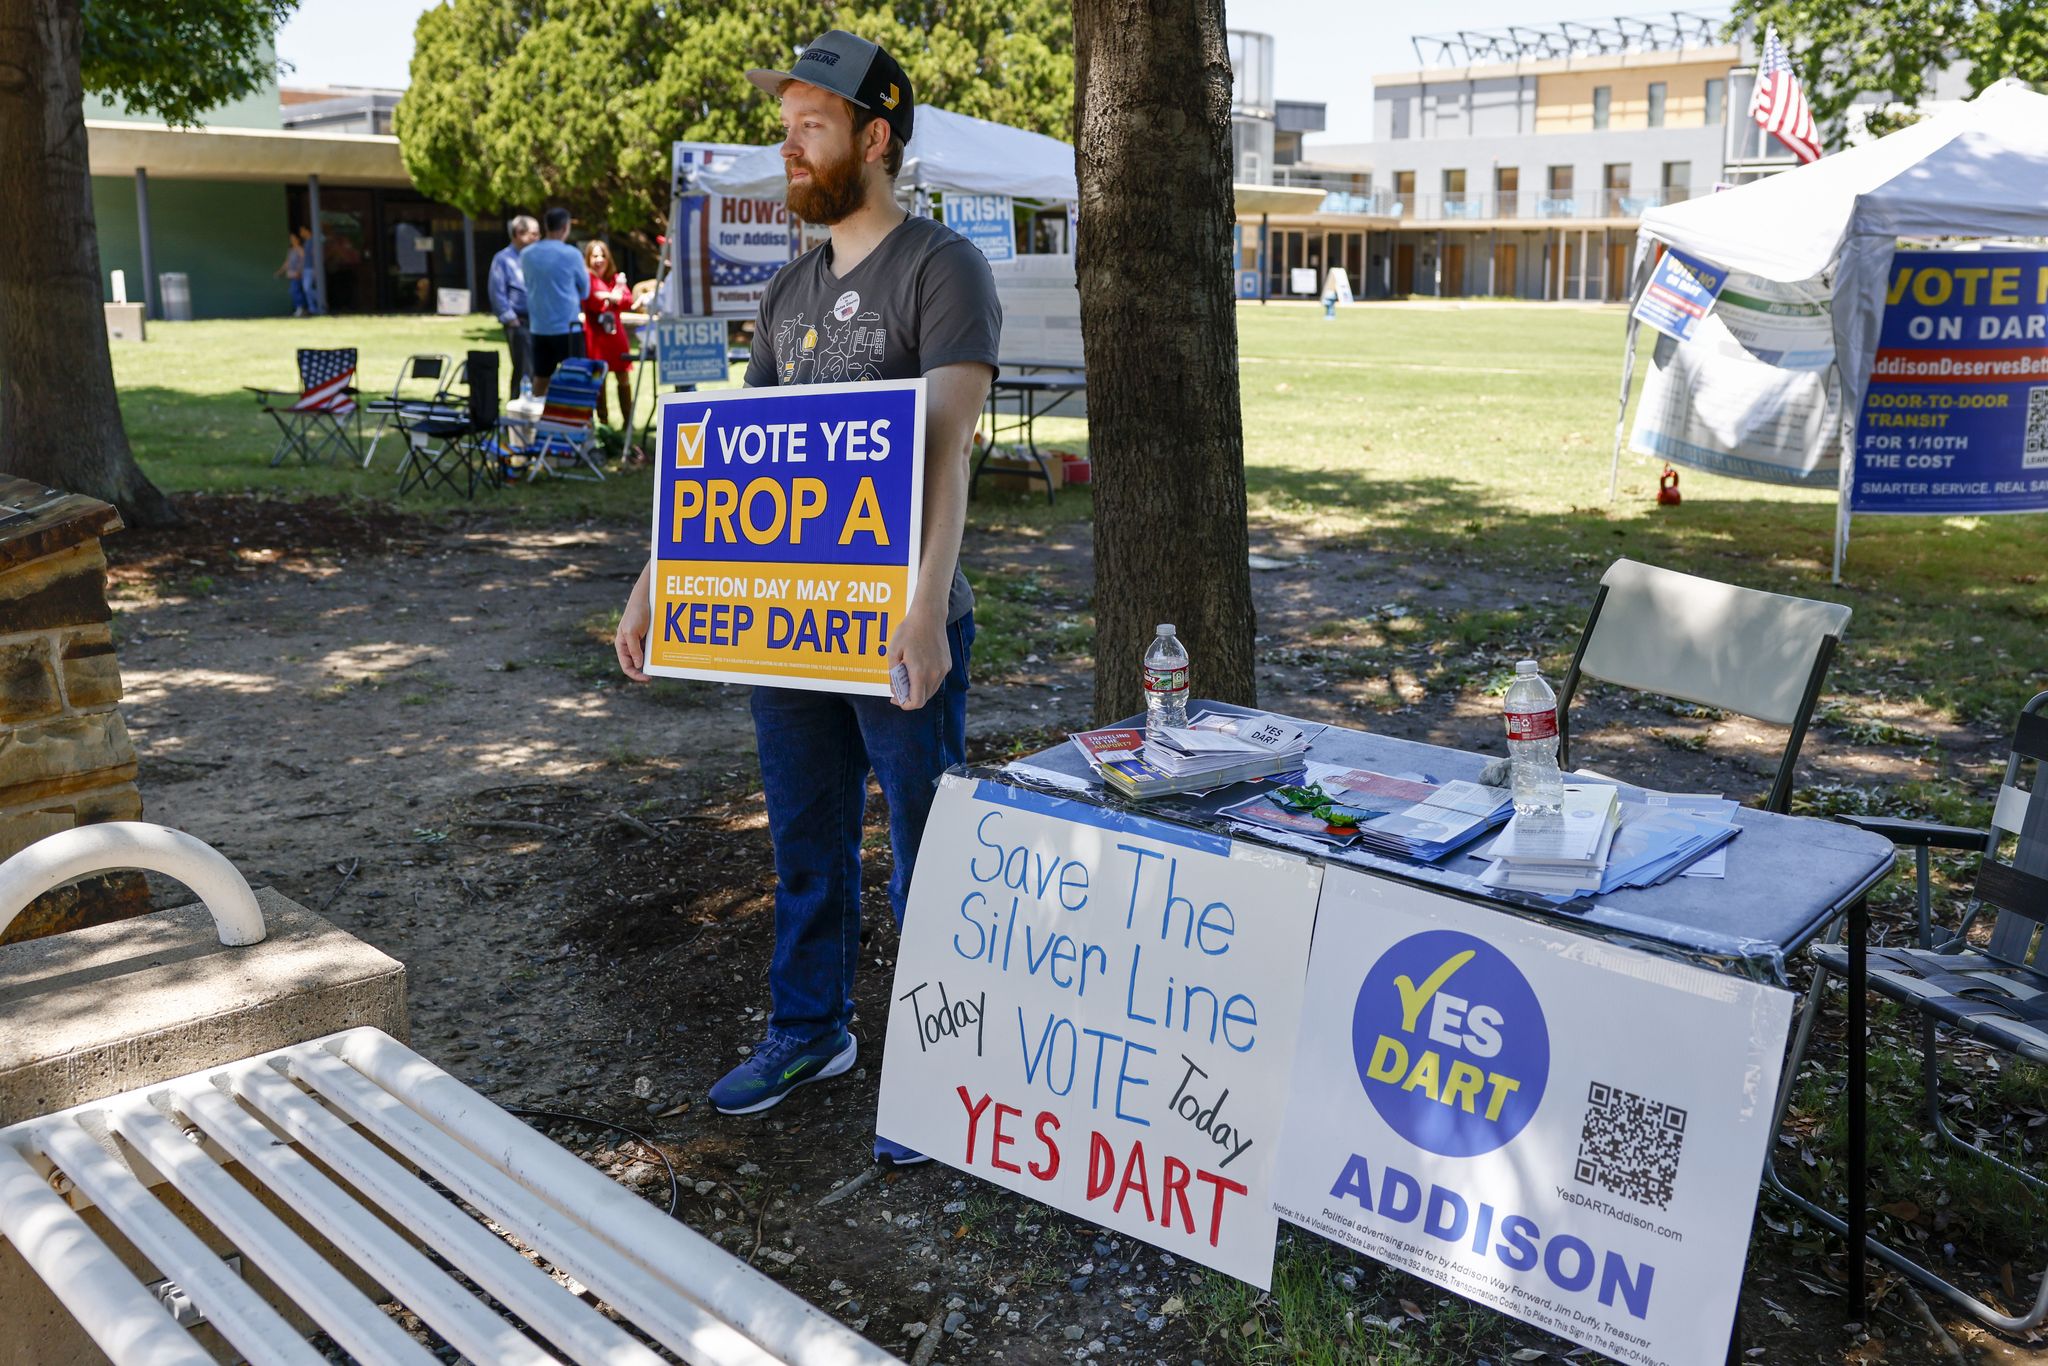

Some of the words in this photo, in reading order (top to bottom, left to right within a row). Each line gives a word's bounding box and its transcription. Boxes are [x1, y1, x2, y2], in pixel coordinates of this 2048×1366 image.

[947, 195, 1009, 222] TRISH
[719, 232, 740, 246] for
[1667, 255, 1698, 282] VOTE
[1698, 272, 1717, 289] NO
[1884, 267, 2021, 306] VOTE
[660, 322, 722, 347] TRISH
[1908, 316, 1963, 340] ON
[1979, 315, 2048, 340] DAR
[1871, 356, 2048, 375] ddisonDeservesBet
[1867, 394, 2009, 408] DOOR-TO-DOOR
[1867, 414, 1949, 428] TRANSIT
[717, 423, 808, 464] VOTE
[820, 418, 892, 462] YES
[1863, 454, 1901, 468] THE
[1906, 455, 1955, 468] COST
[1864, 436, 1903, 449] FOR
[1907, 436, 1969, 449] 1/10TH
[1861, 482, 1928, 495] SMARTER
[1931, 482, 1991, 495] SERVICE.
[1994, 481, 2027, 493] REAL
[671, 476, 828, 546] PROP
[837, 476, 891, 547] A
[666, 575, 748, 598] ELECTION
[753, 578, 791, 600] DAY
[796, 579, 840, 602] MAY
[846, 581, 892, 604] 2ND
[664, 601, 754, 647] KEEP
[766, 606, 888, 657] DART!
[1251, 731, 1279, 745] DART
[1264, 724, 1284, 737] YES
[970, 811, 1089, 911] Save
[1117, 843, 1235, 955] The
[953, 891, 1106, 996] Silver
[1127, 943, 1258, 1052] Line
[899, 981, 986, 1057] Today
[1393, 949, 1505, 1058] YES
[1017, 1006, 1157, 1127] VOTE
[1366, 1034, 1521, 1123] DART
[1168, 1053, 1253, 1168] Today
[956, 1085, 1061, 1181] YES
[1086, 1130, 1248, 1247] DART
[1556, 1186, 1683, 1242] YesDARTAddison.com
[1329, 1153, 1655, 1320] ADDISON
[1272, 1202, 1294, 1218] Notice:
[1305, 1215, 1311, 1225] A
[1311, 1218, 1338, 1236] Violation
[1338, 1229, 1348, 1239] Of
[1347, 1232, 1362, 1247] State
[1363, 1240, 1376, 1252] Law
[1376, 1247, 1407, 1266] (Chapters
[1408, 1259, 1420, 1271] 392
[1421, 1265, 1434, 1277] and
[1434, 1271, 1449, 1285] 393,
[1450, 1276, 1498, 1302] Transportation
[1523, 1306, 1532, 1317] To
[1532, 1310, 1552, 1325] Place
[1554, 1318, 1568, 1332] This
[1569, 1325, 1585, 1340] Sign
[1585, 1331, 1593, 1342] In
[1594, 1335, 1608, 1349] The
[1321, 1208, 1356, 1229] Political
[1357, 1225, 1403, 1250] advertising
[1403, 1243, 1424, 1256] paid
[1425, 1250, 1438, 1262] for
[1439, 1256, 1450, 1268] by
[1450, 1262, 1488, 1283] Addison
[1490, 1276, 1510, 1293] Way
[1511, 1285, 1552, 1311] Forward,
[1554, 1304, 1572, 1318] Jim
[1573, 1311, 1600, 1331] Duffy,
[1604, 1322, 1652, 1348] Treasurer
